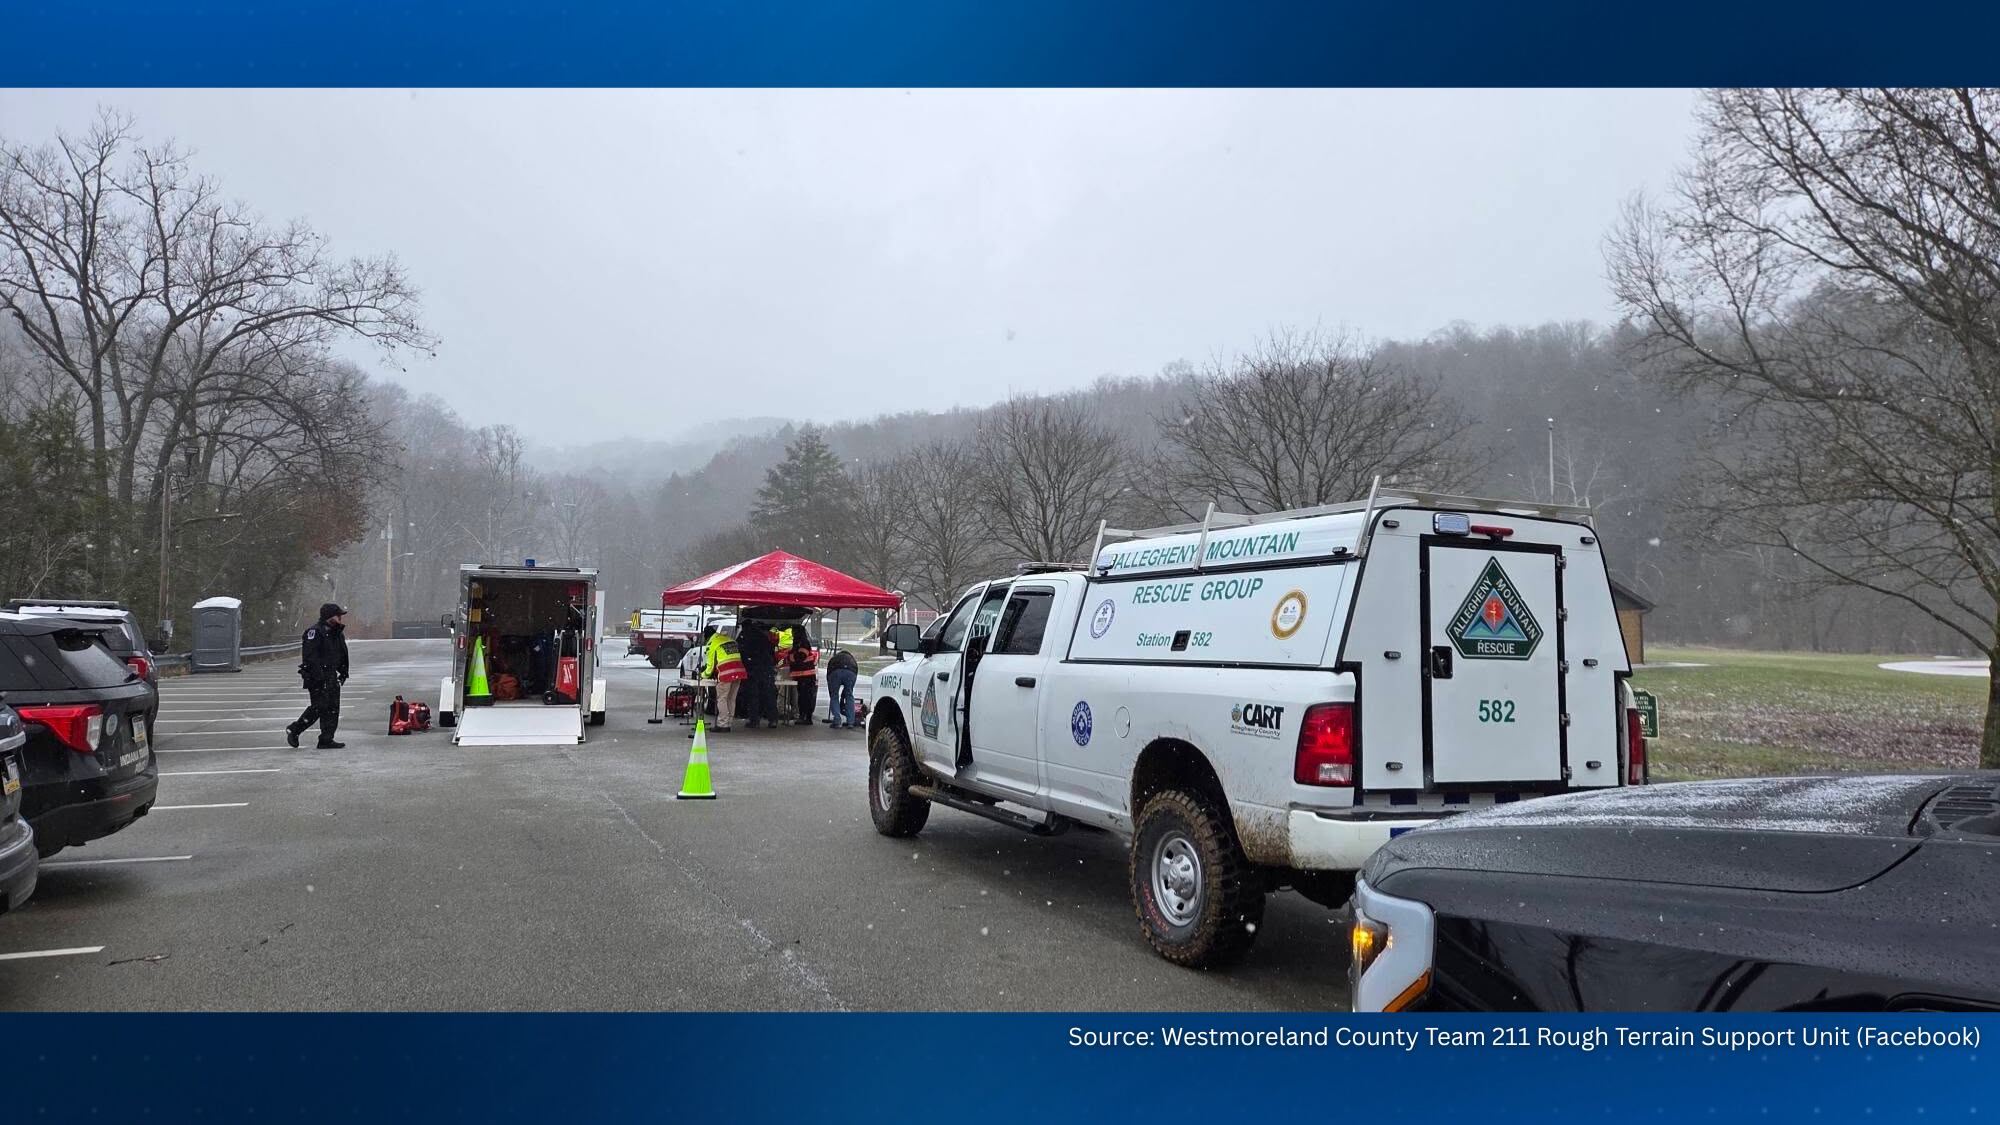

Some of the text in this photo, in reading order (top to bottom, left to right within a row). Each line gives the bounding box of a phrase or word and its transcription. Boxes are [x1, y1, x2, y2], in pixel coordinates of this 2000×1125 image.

[1114, 532, 1300, 570] ALLEGHENY MOUNTAIN
[1132, 577, 1263, 604] RESCUE GROUP
[1453, 576, 1537, 640] ALLEGHENY MOUNTAIN
[1136, 631, 1212, 647] Station 582
[1477, 641, 1515, 654] RESCUE
[879, 675, 903, 689] AMRG-1
[1242, 703, 1284, 730] CART
[1478, 700, 1516, 723] 582
